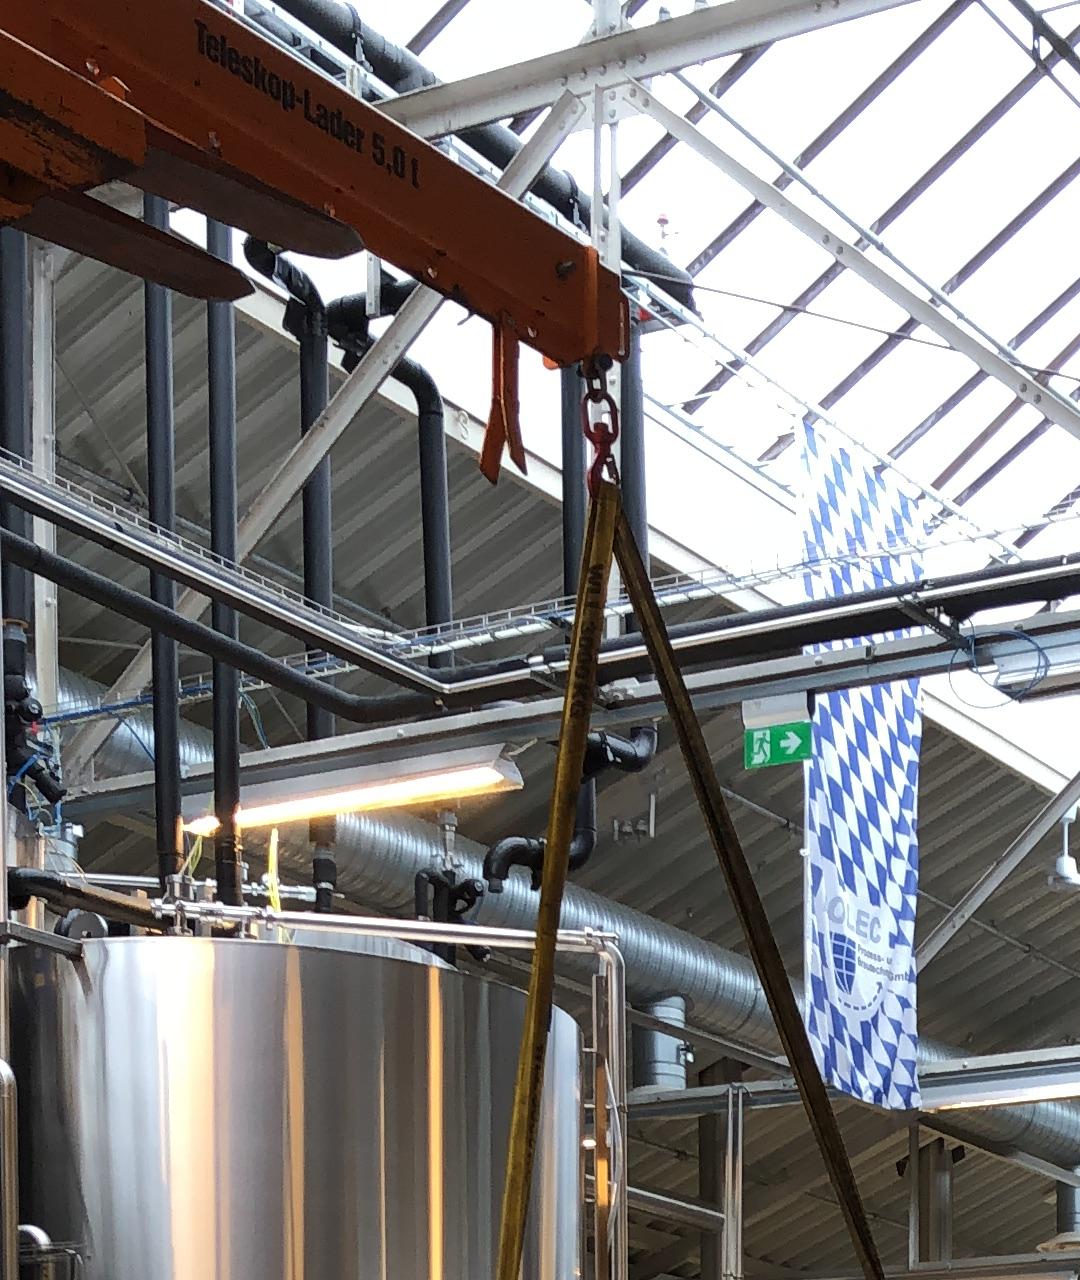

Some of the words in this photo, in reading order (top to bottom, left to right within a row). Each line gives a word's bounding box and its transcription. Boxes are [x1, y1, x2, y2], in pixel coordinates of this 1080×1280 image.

[194, 18, 365, 153] Teleskop-Lader
[371, 131, 406, 179] 5,0
[826, 896, 881, 944] OLEC
